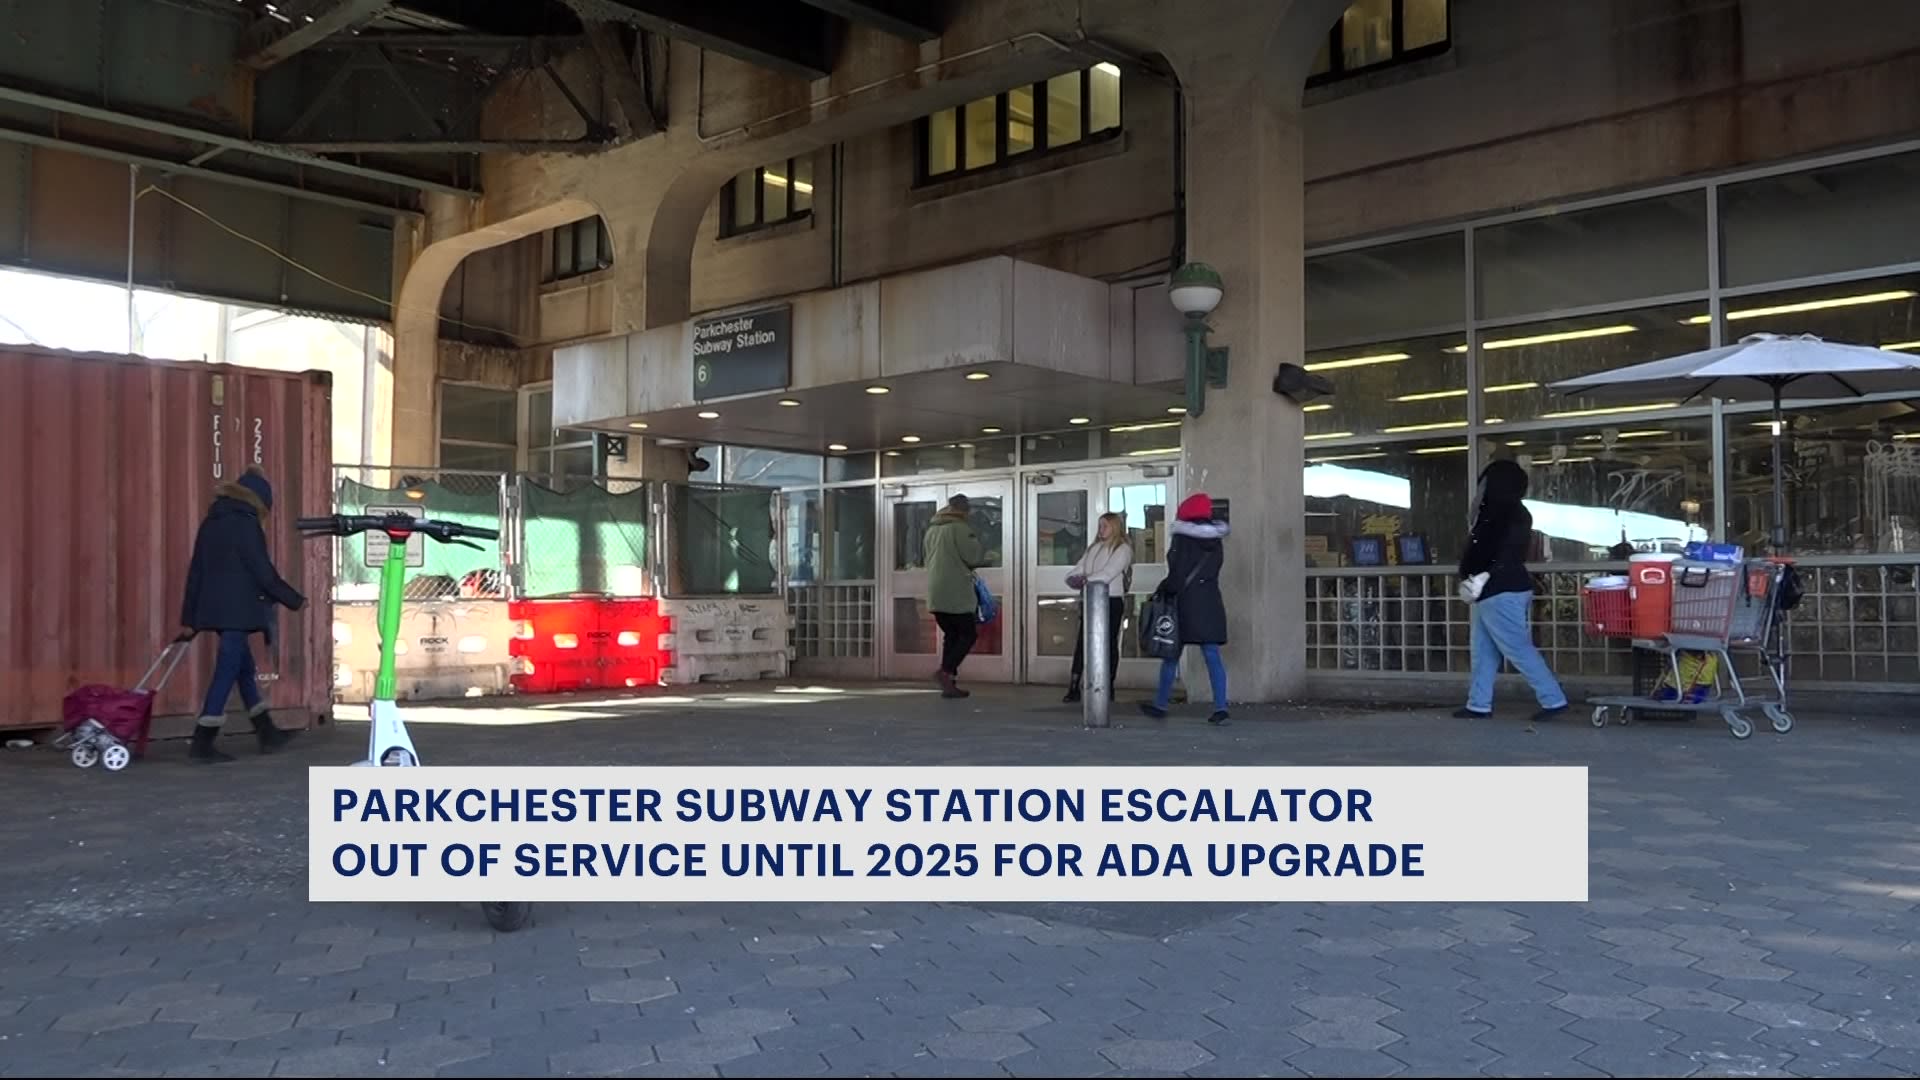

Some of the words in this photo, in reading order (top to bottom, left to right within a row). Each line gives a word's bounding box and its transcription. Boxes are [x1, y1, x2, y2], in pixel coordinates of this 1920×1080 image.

[694, 318, 754, 339] Parkchester
[694, 339, 733, 355] Subway
[736, 330, 775, 348] Station
[698, 365, 707, 382] 6
[213, 414, 223, 478] FCIU
